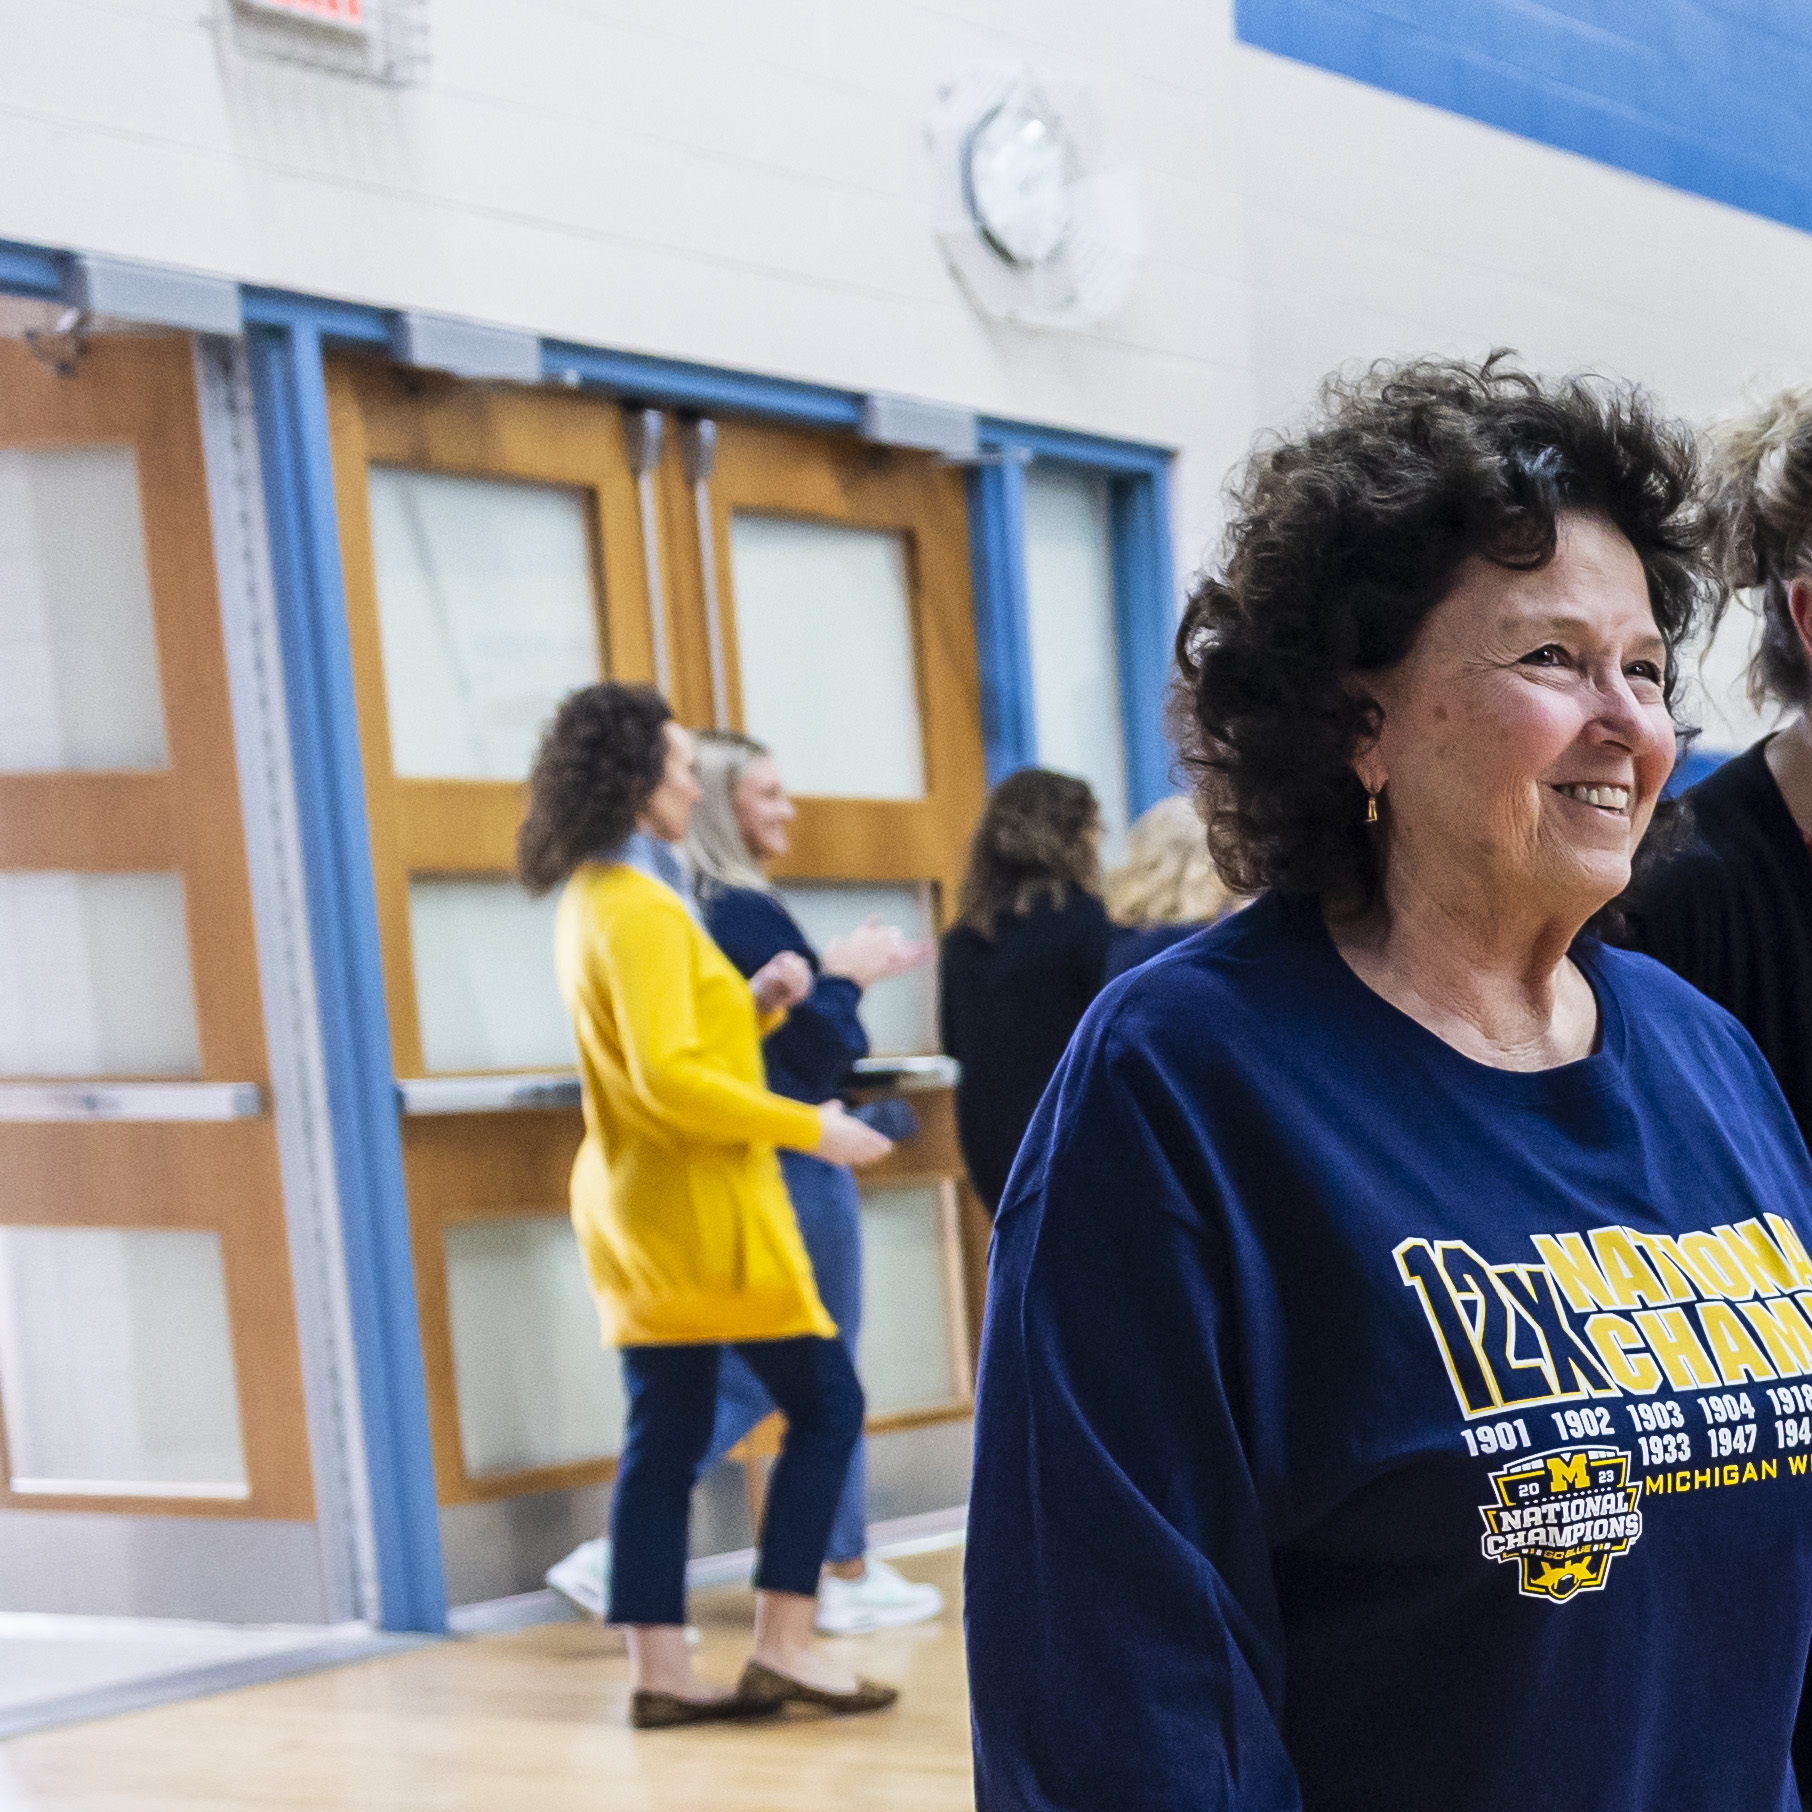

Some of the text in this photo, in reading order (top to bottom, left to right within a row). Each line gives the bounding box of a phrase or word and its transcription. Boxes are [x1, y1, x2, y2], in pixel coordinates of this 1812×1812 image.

[1392, 1237, 1623, 1421] 12X
[1461, 1418, 1531, 1457] 1901
[1551, 1406, 1615, 1441] 1902
[1626, 1400, 1685, 1432] 1903
[1697, 1392, 1756, 1424] 1904
[1638, 1432, 1691, 1466] 1933
[1707, 1423, 1757, 1458] 1947
[1518, 1453, 1615, 1498] 20 M 23
[1645, 1458, 1777, 1496] MICHIGAN
[1499, 1491, 1629, 1532] NATIONAL
[1486, 1513, 1639, 1556] CHAMPIONS
